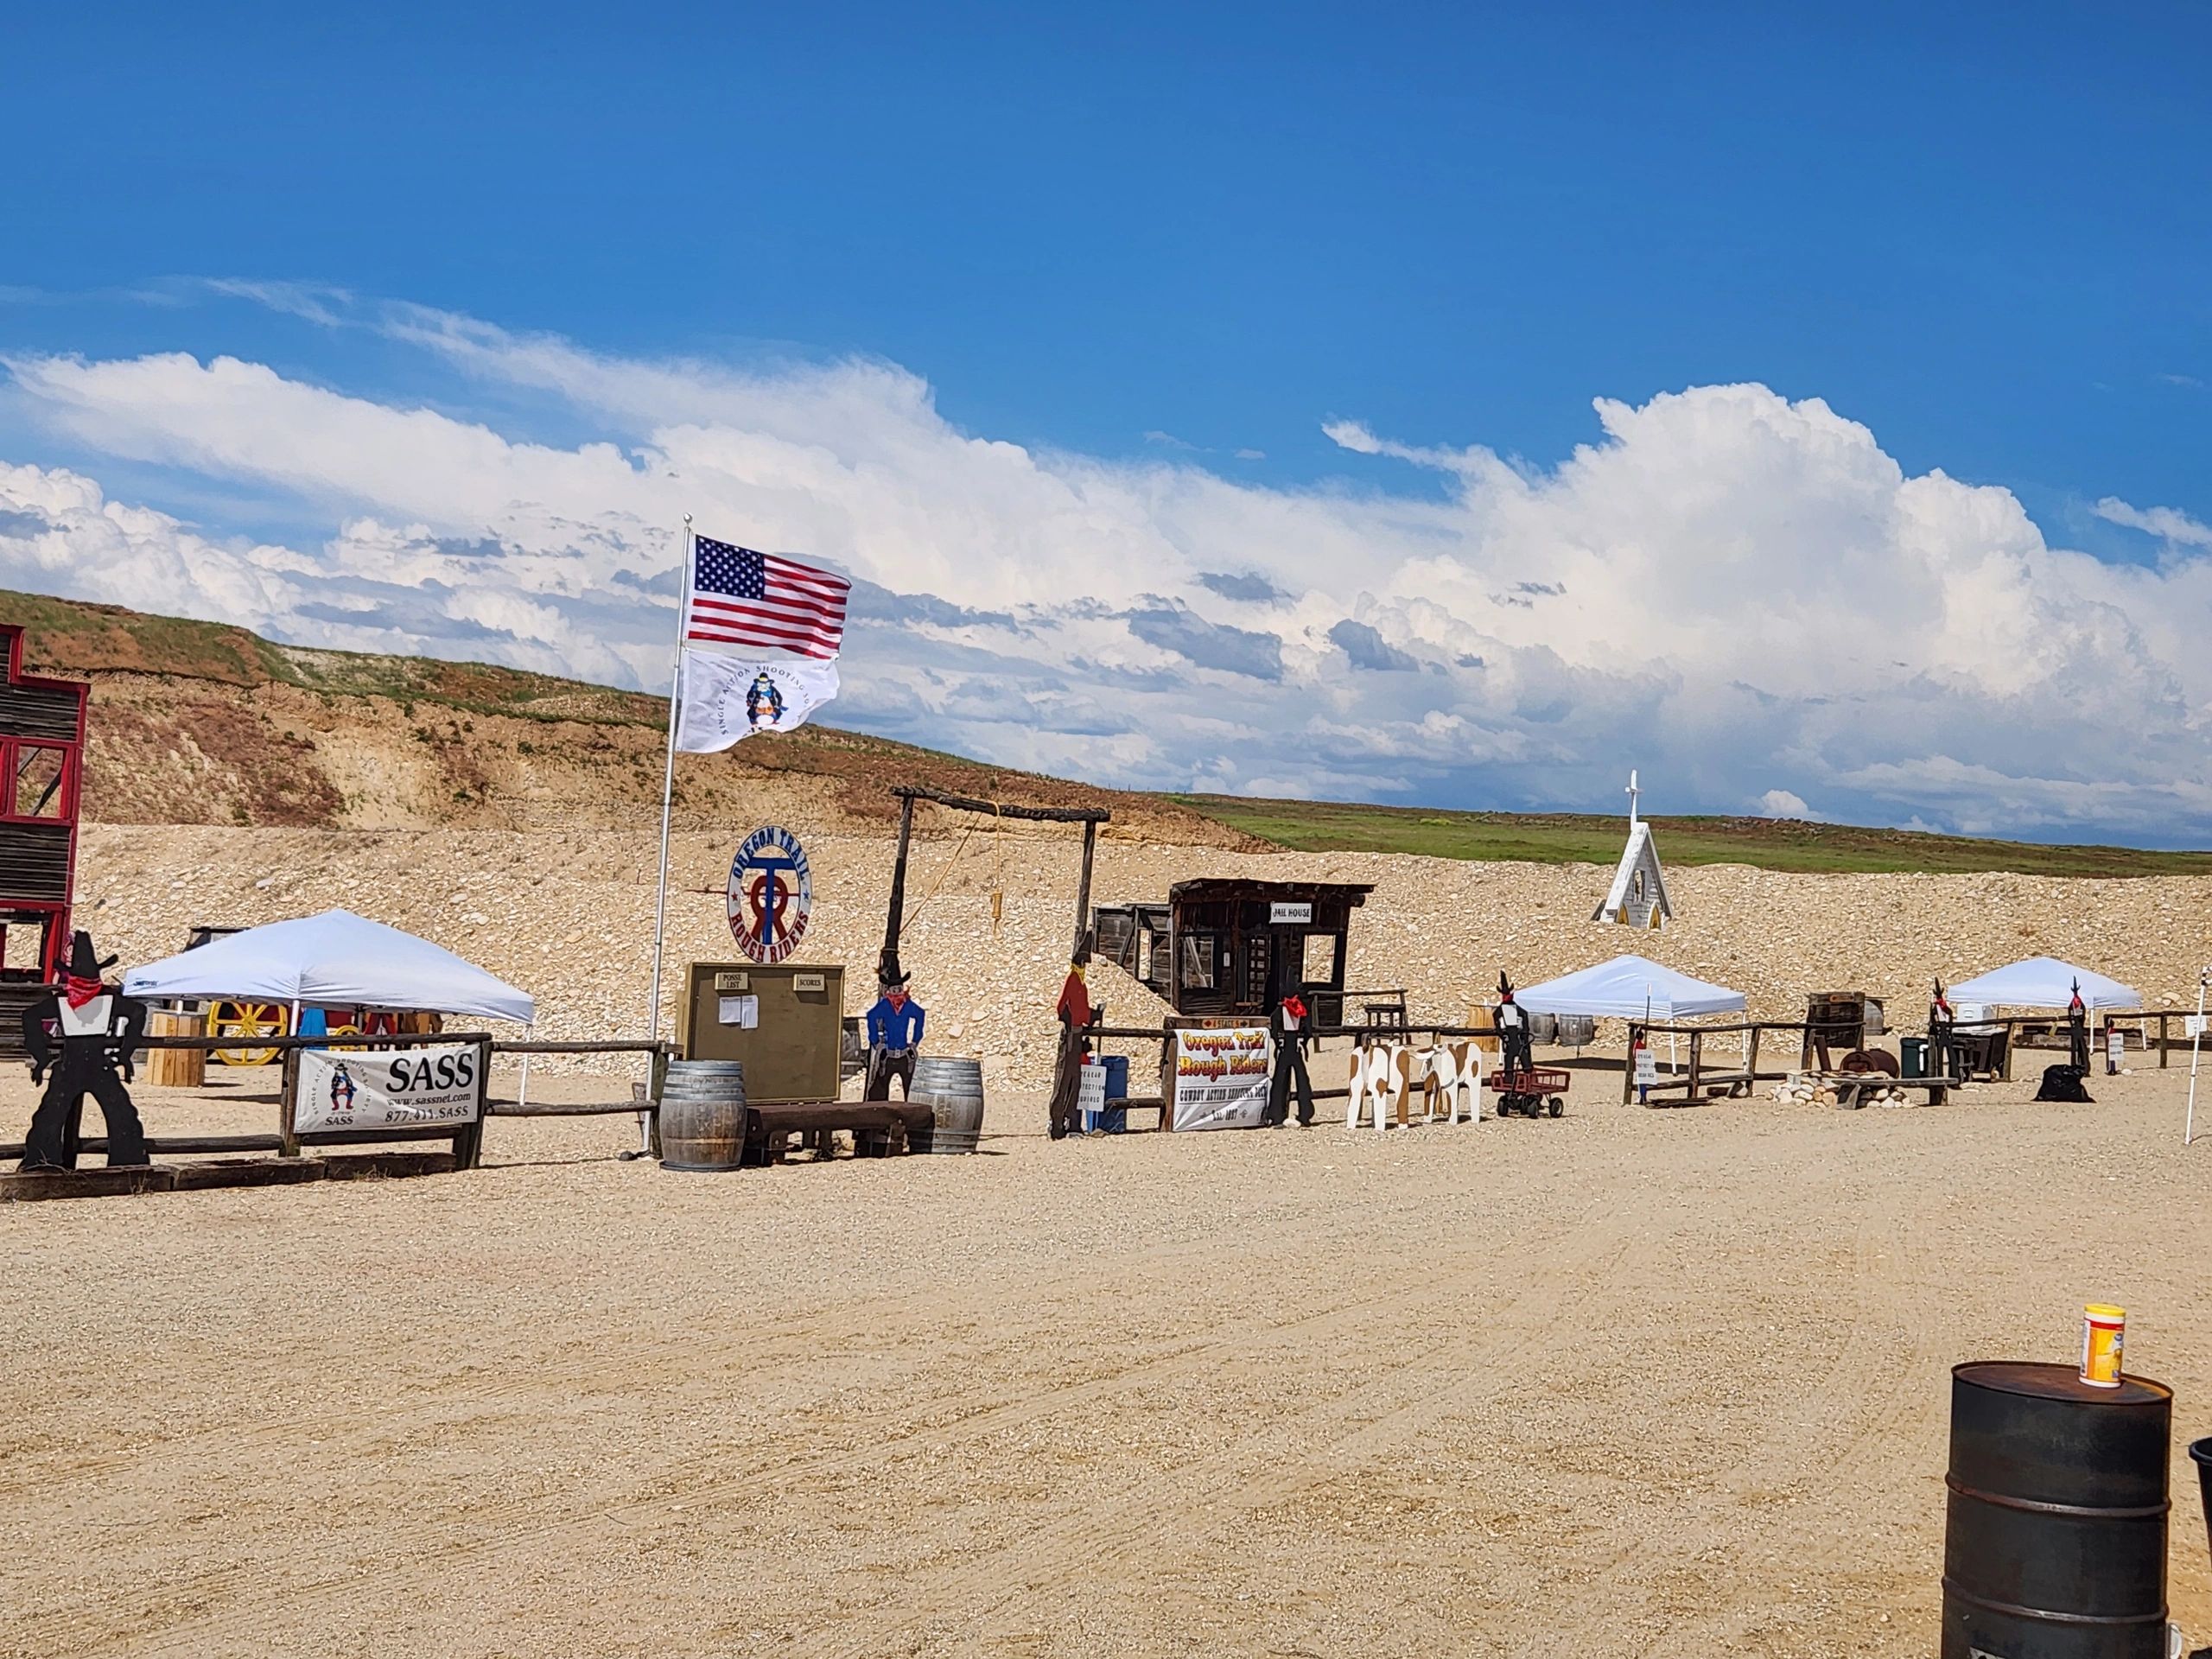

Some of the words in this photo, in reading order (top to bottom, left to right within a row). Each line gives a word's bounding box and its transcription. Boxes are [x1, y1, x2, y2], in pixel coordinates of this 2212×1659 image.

[756, 665, 804, 690] SHOOTING
[733, 827, 774, 880] OREGON
[779, 828, 810, 880] TRAIL
[1273, 908, 1287, 917] JAIL
[1288, 908, 1310, 918] HOUSE
[731, 912, 765, 963] ROUGH
[770, 911, 810, 963] RIDERS
[799, 978, 822, 987] SCORES
[1183, 1031, 1236, 1057] Oregon
[1233, 1031, 1265, 1050] Trail
[385, 1052, 474, 1092] SASS
[1179, 1055, 1228, 1082] Rough
[1230, 1054, 1268, 1074] Riders
[387, 1093, 471, 1106] www.sassnet.com
[1180, 1089, 1205, 1102] COWBOY
[1206, 1088, 1227, 1101] ACTION
[325, 1116, 354, 1126] SASS
[385, 1105, 468, 1122] 877.411.SASS
